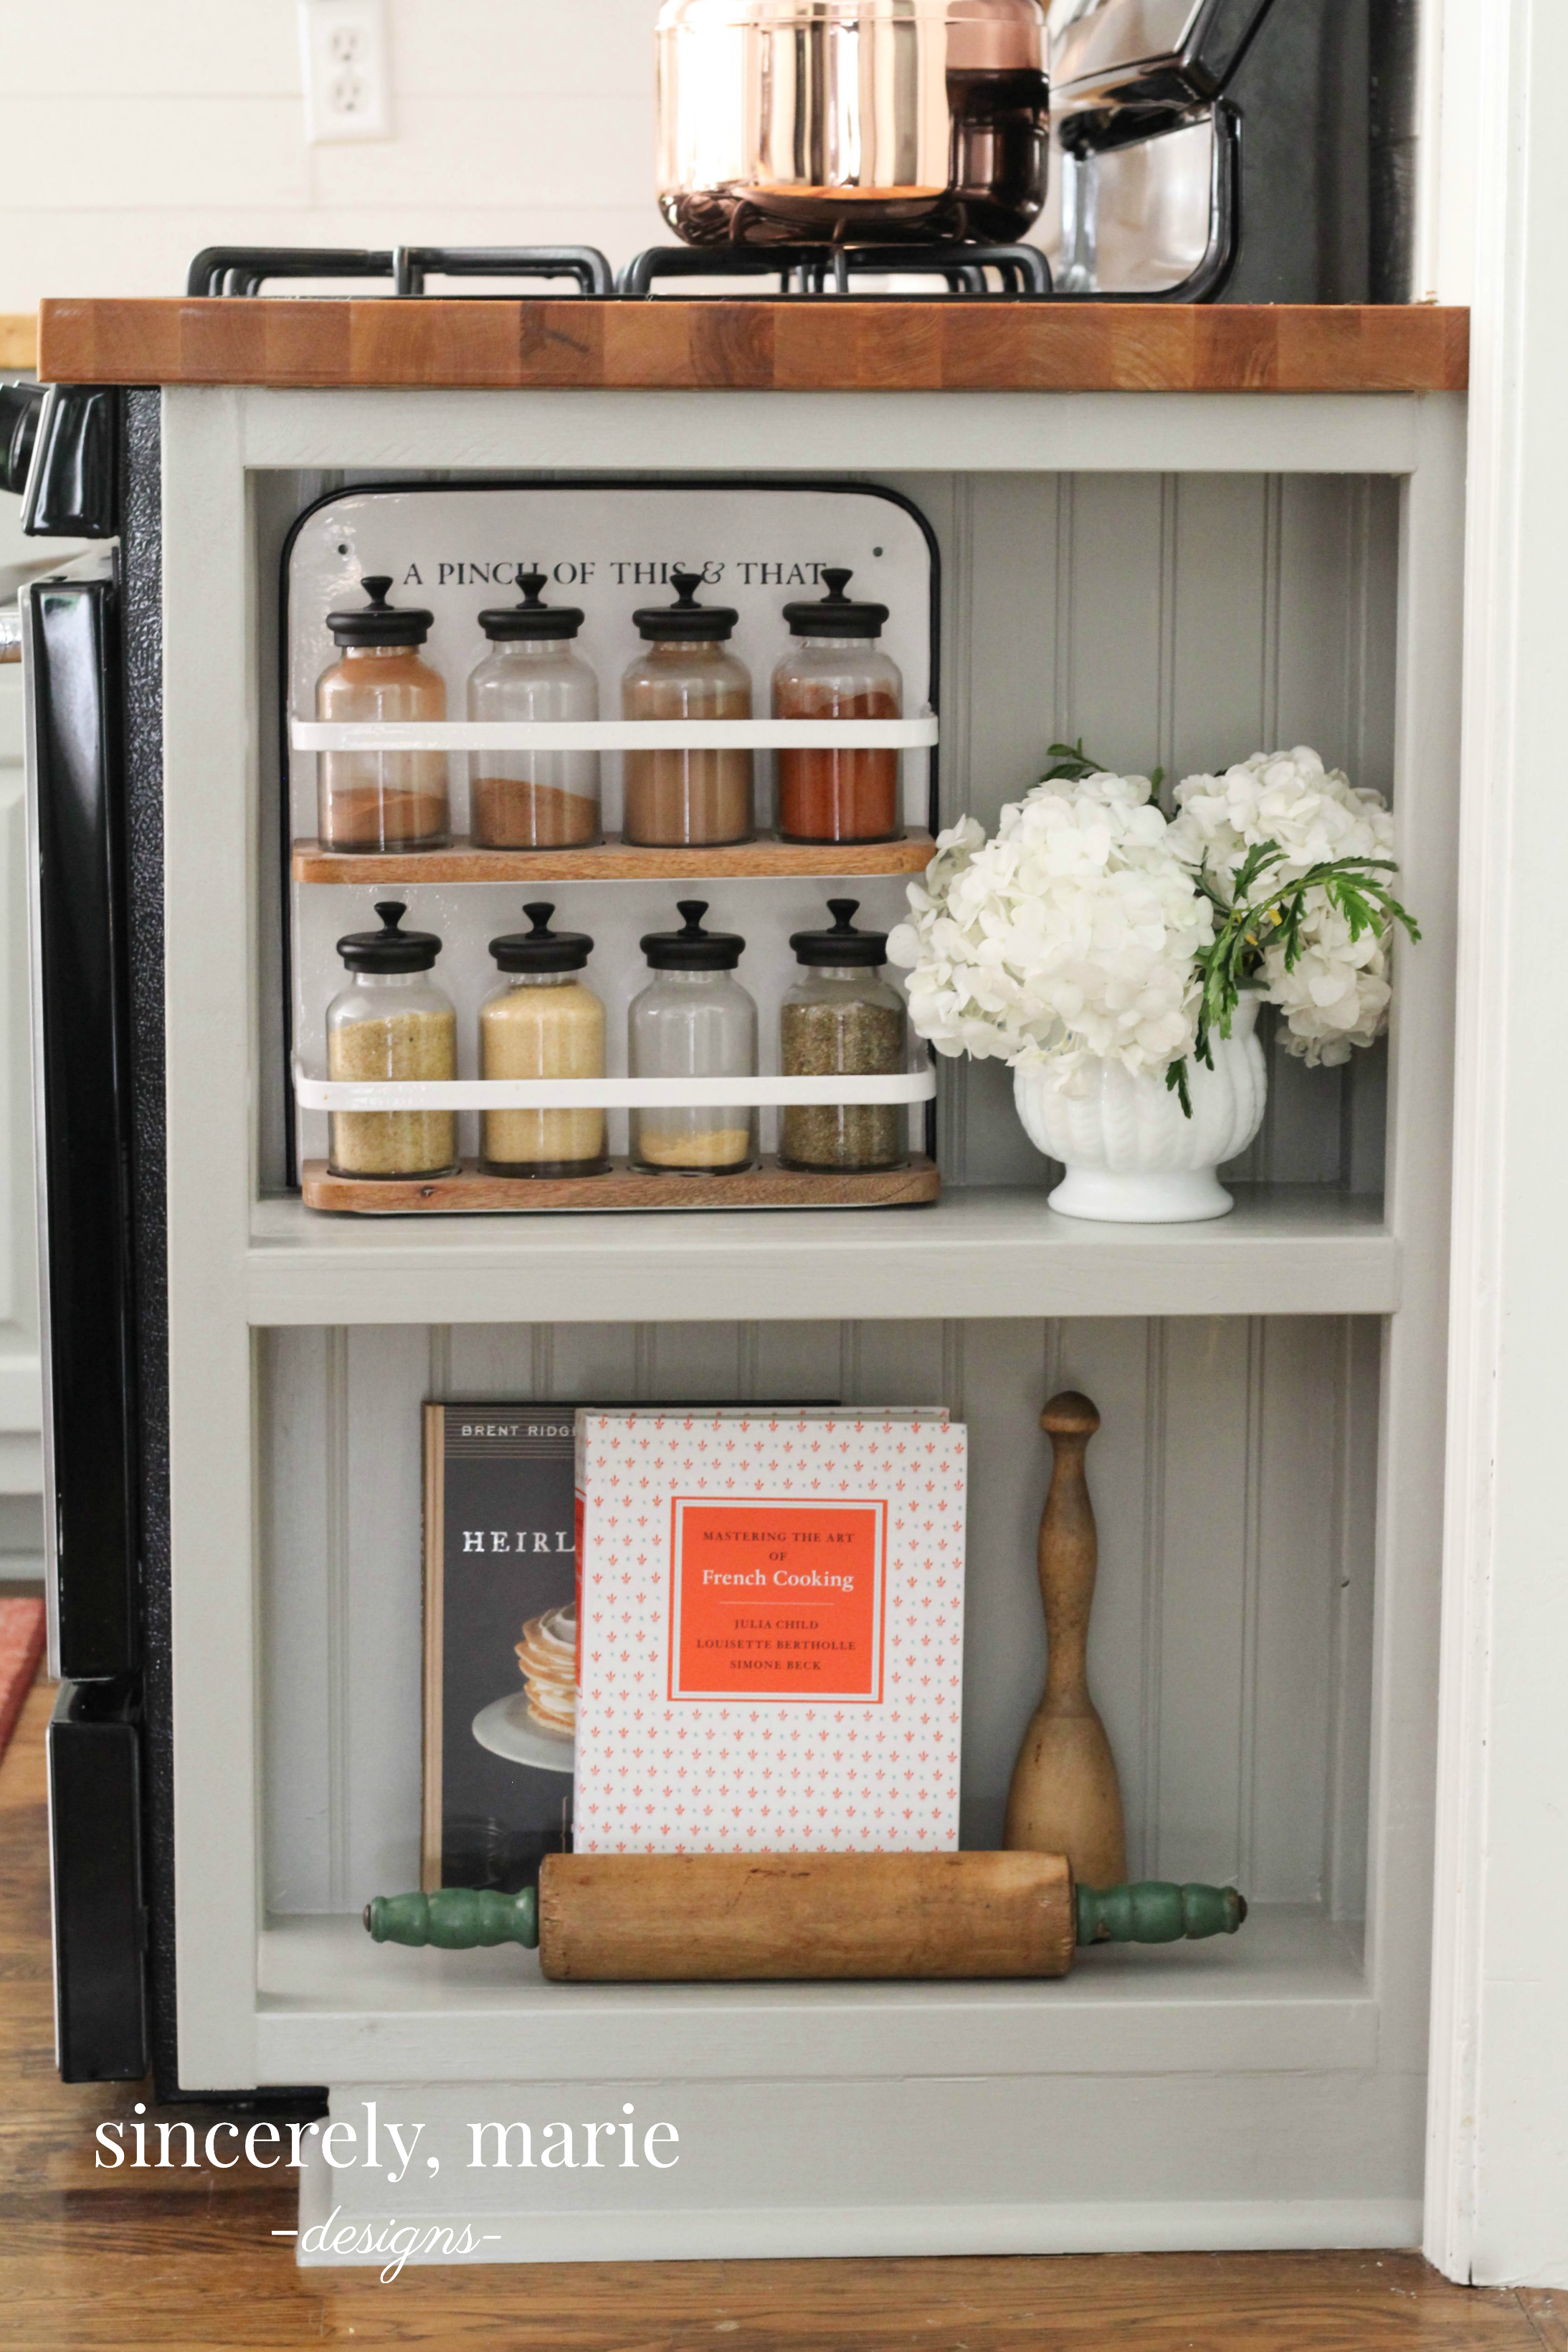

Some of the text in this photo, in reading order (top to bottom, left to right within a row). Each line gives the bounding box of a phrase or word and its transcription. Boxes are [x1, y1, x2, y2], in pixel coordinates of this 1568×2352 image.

[403, 563, 424, 585] A
[553, 562, 596, 585] OF
[702, 561, 725, 584] &
[736, 562, 827, 585] THAT
[462, 1425, 576, 1436] BRENT RIDG
[703, 1531, 854, 1542] MASTERING THE ART
[769, 1552, 787, 1561] OF
[703, 1568, 854, 1592] French Cooking
[734, 1619, 819, 1630] JULIA CHILD
[697, 1639, 856, 1650] LOUISETTE BERTHOLLE
[730, 1660, 821, 1670] SIMONE BECK
